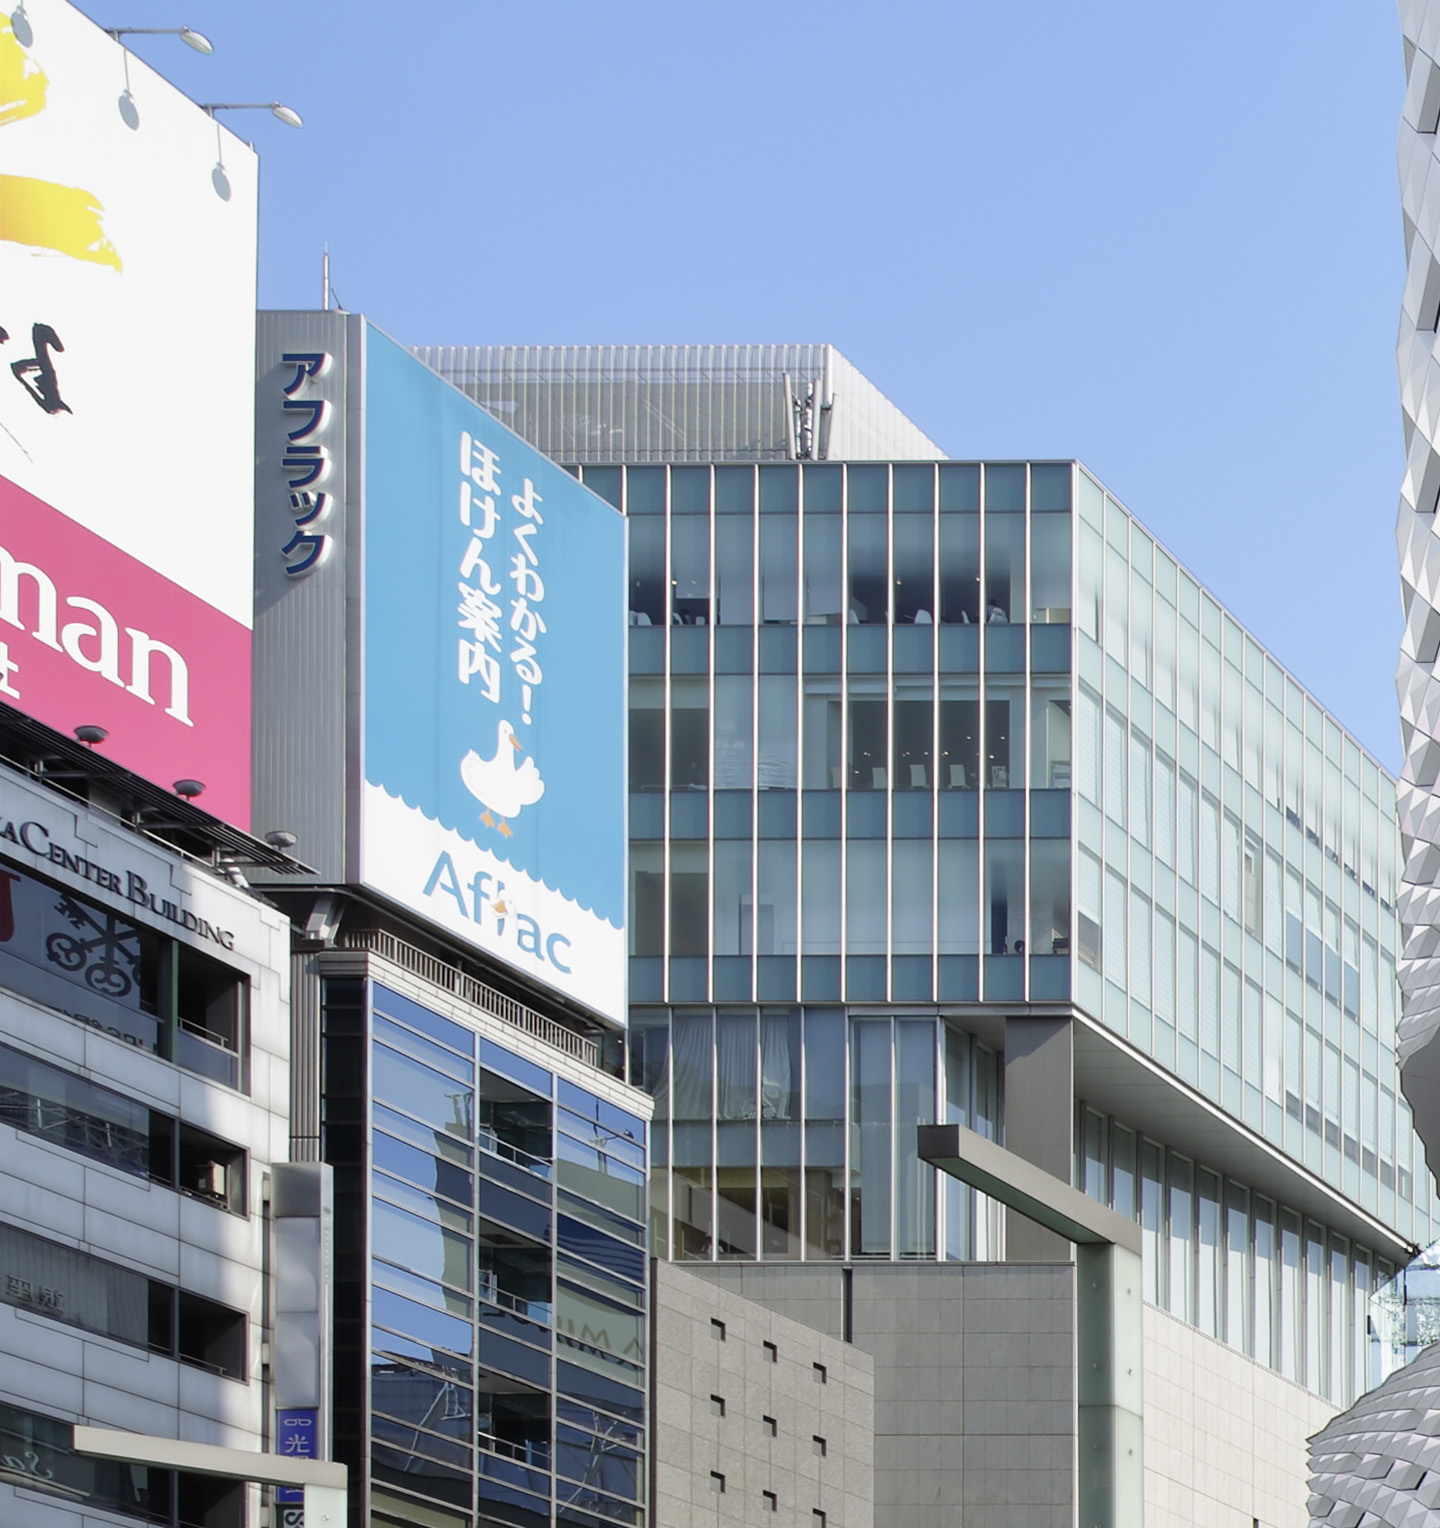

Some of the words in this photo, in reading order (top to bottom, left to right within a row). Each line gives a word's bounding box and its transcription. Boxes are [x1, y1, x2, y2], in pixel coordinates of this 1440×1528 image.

[280, 353, 332, 578] アフラック
[458, 429, 502, 704] ほけん案内
[508, 476, 547, 726] よくわかる！
[422, 849, 573, 975] Aflac
